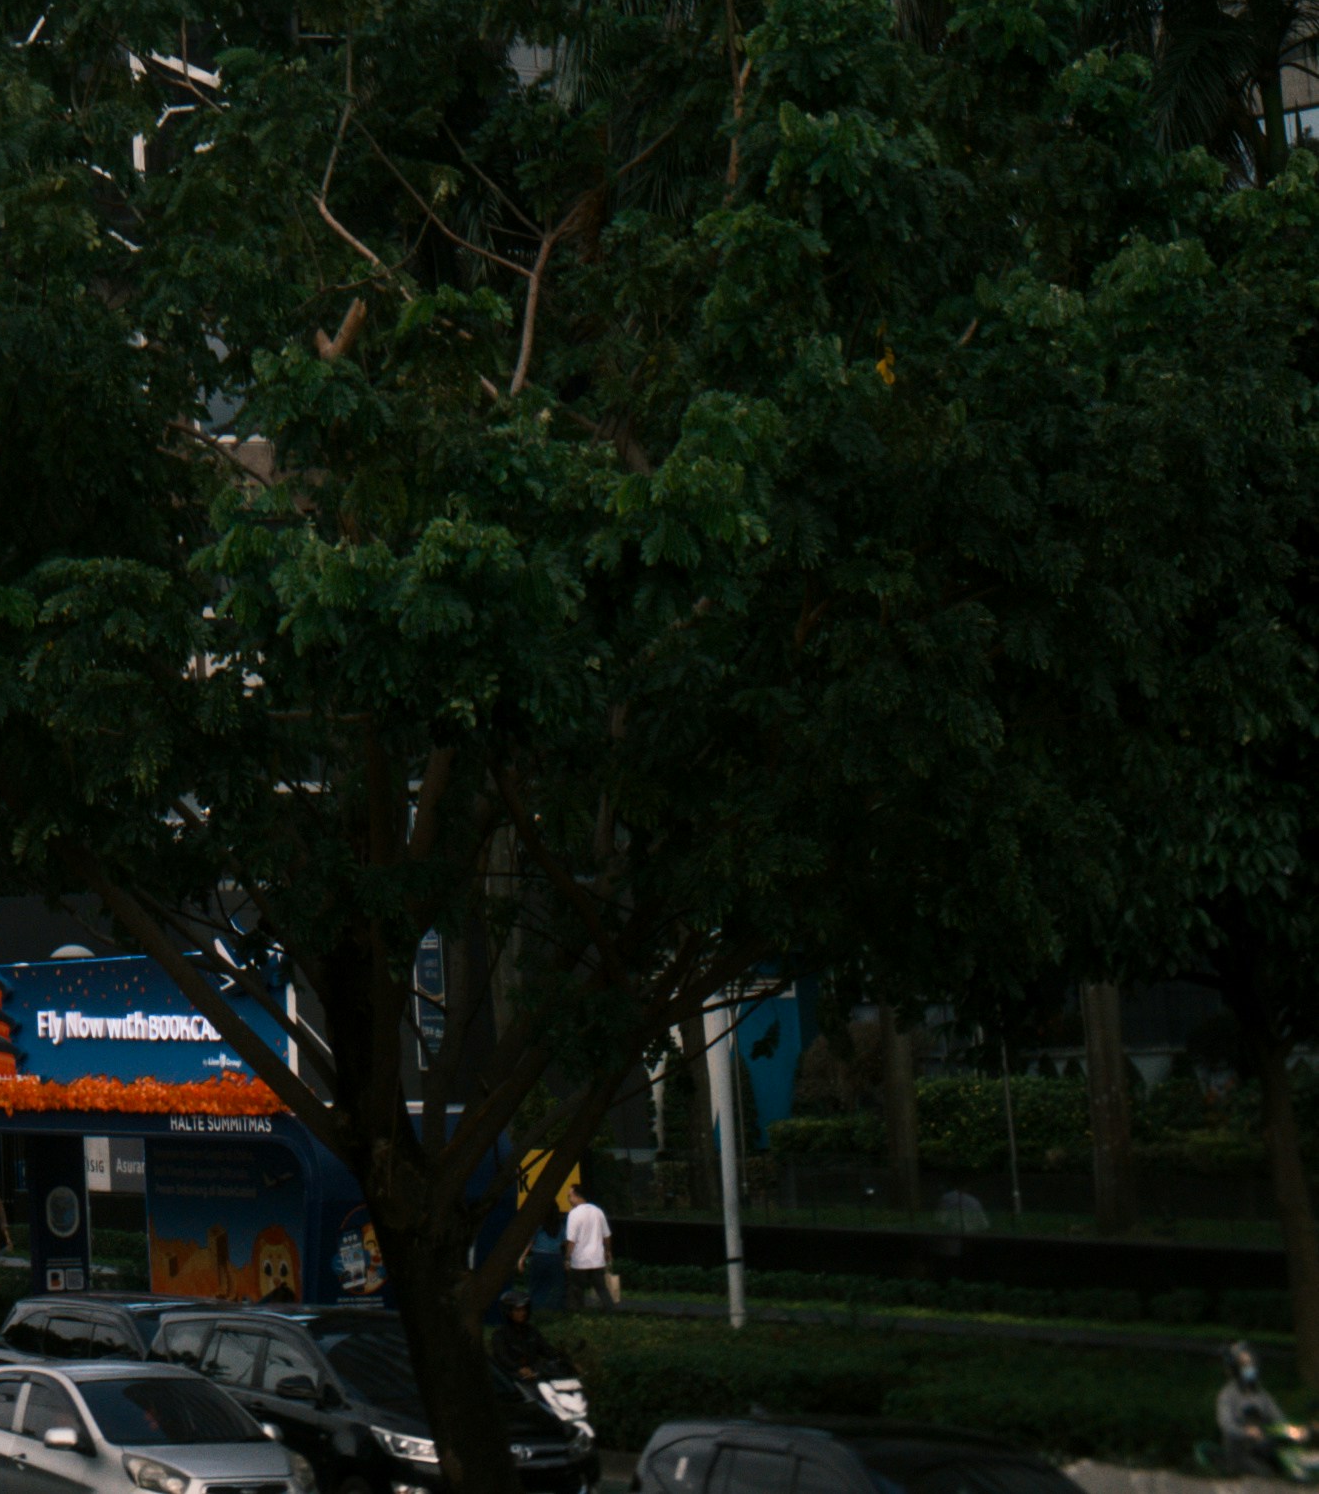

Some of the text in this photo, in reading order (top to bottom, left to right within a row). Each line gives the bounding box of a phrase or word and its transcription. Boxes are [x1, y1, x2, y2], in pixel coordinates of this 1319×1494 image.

[36, 1009, 65, 1046] Fly
[65, 1011, 106, 1040] Now
[106, 1009, 148, 1040] with
[169, 1115, 273, 1133] HALTE SUMMITMAS
